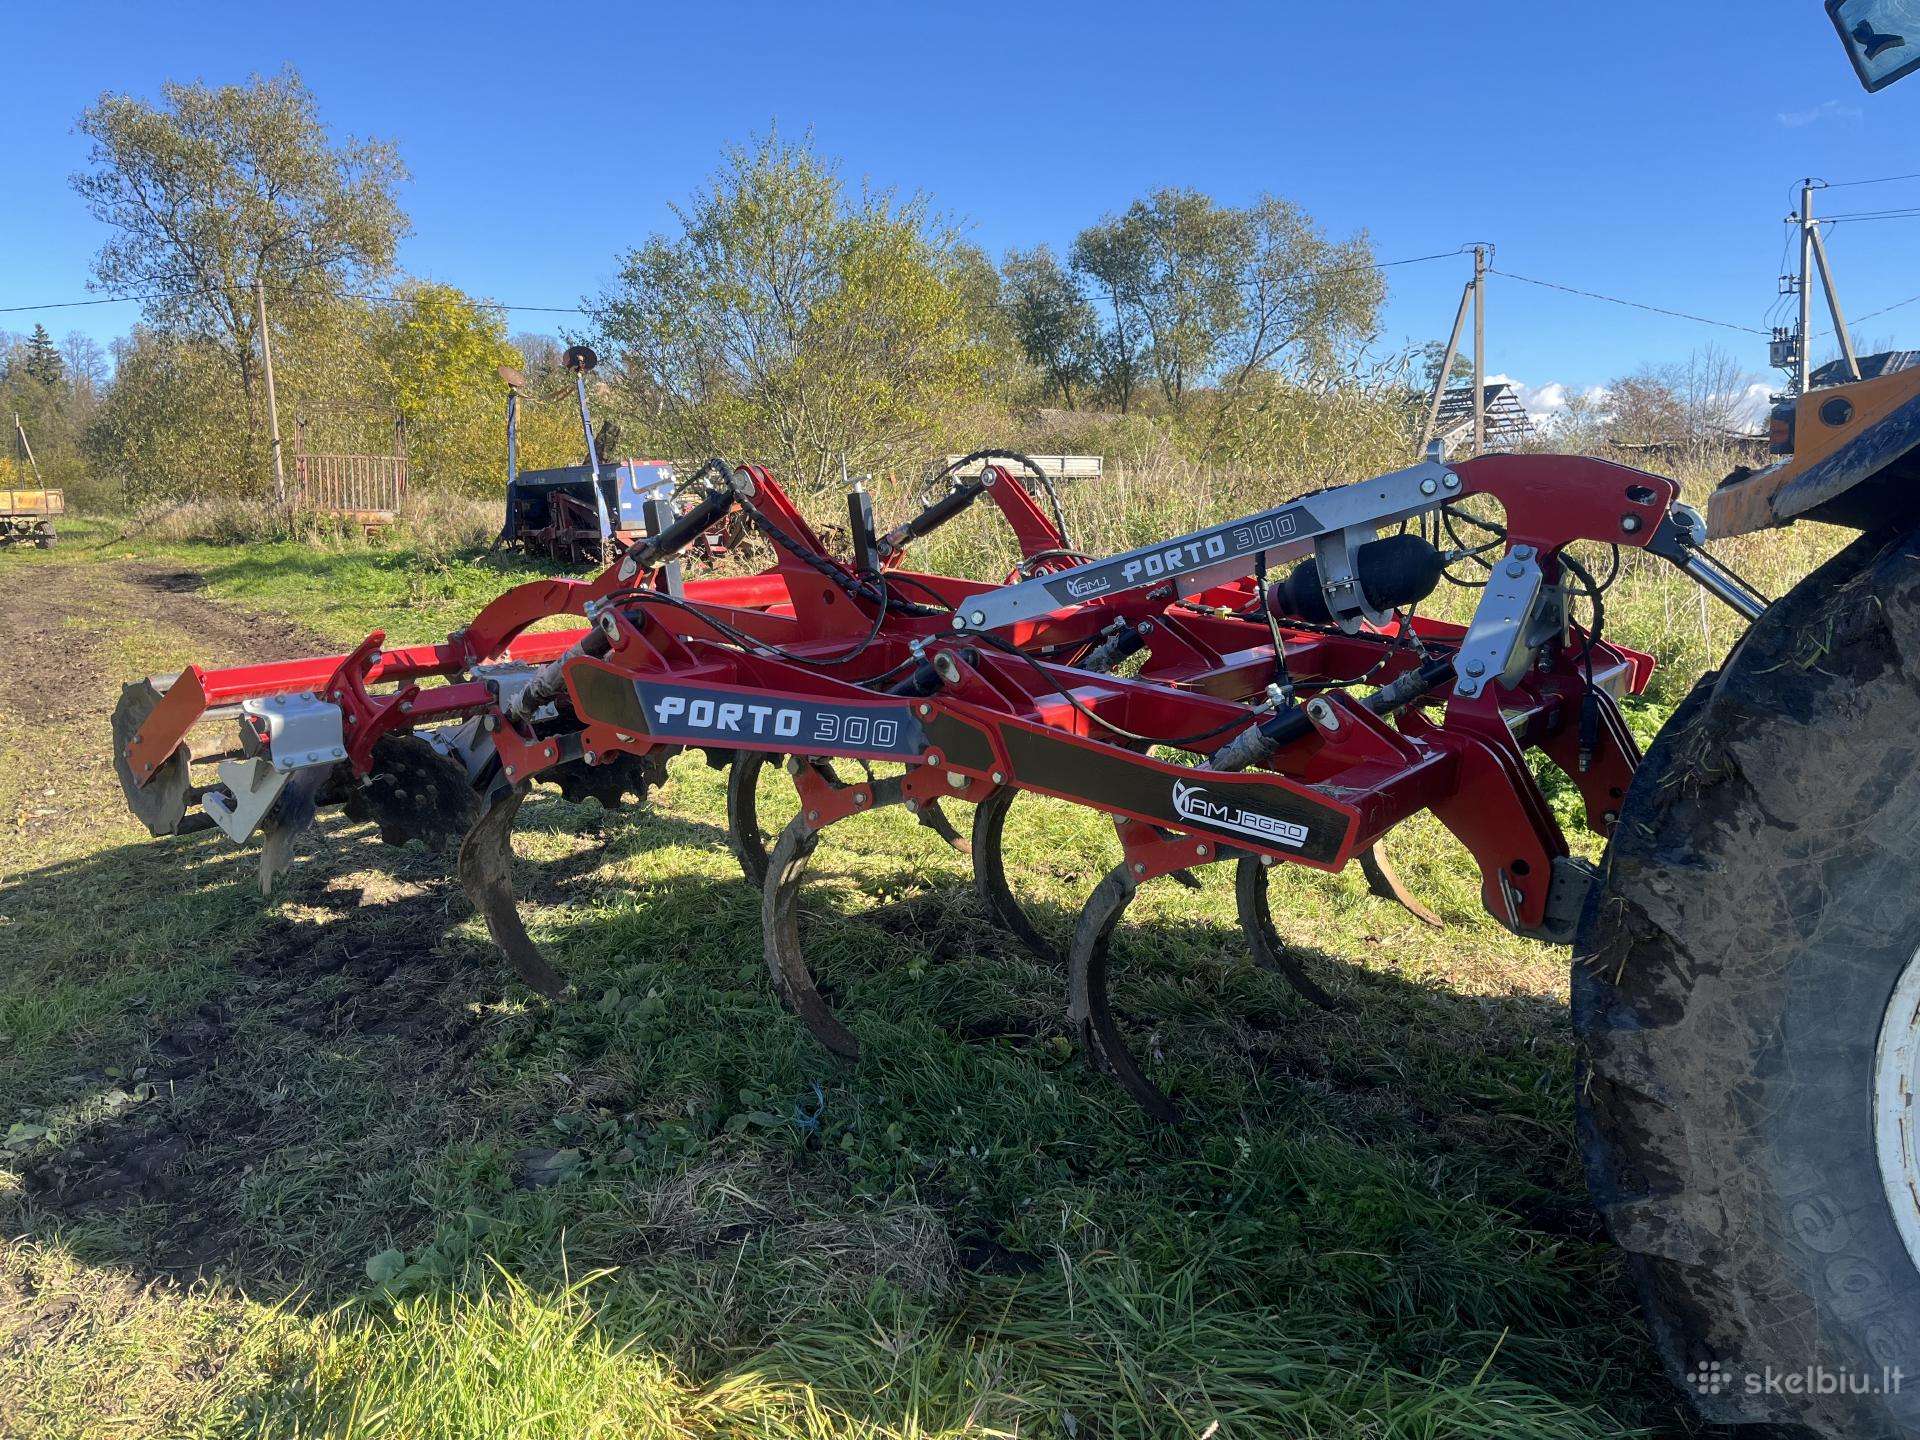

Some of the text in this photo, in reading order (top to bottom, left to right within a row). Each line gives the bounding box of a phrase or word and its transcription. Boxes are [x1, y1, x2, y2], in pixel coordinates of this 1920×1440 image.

[1122, 535, 1226, 583] PORTO
[1233, 513, 1297, 550] 300
[654, 696, 898, 748] PORTO 300
